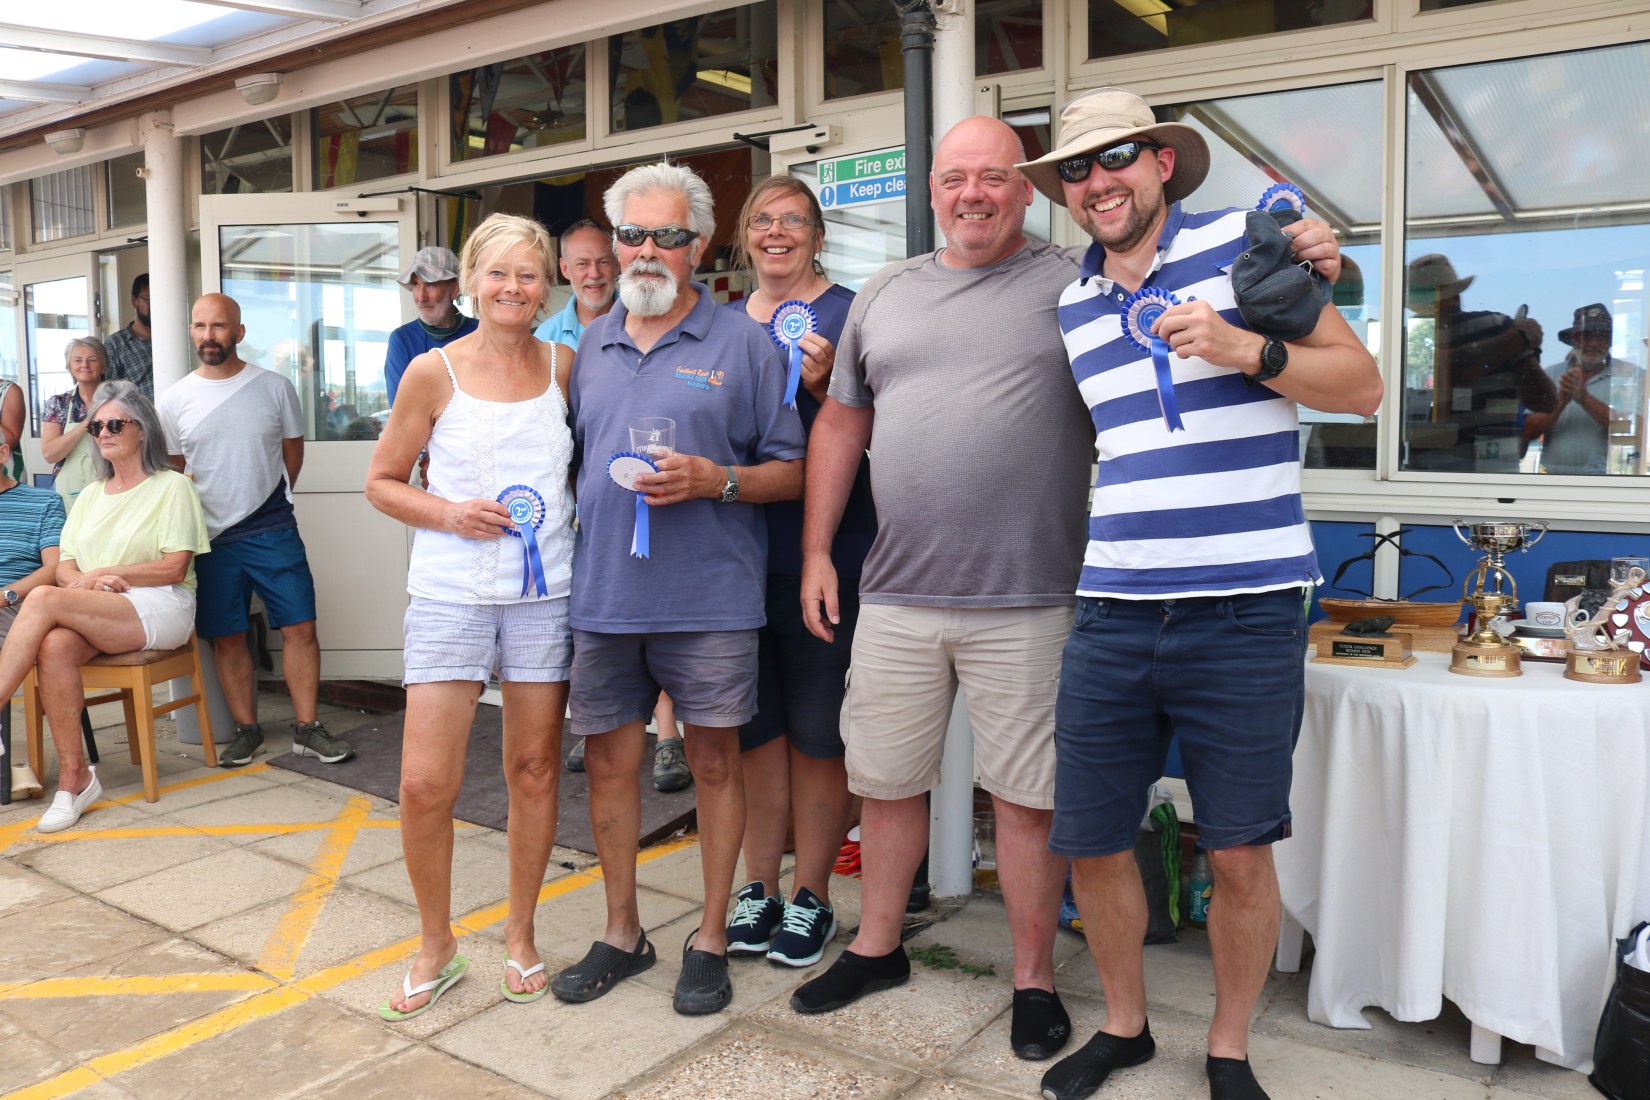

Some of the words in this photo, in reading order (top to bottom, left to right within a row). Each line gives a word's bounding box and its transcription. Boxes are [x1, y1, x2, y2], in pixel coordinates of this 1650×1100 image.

[855, 159, 882, 176] Fire
[885, 152, 906, 171] exi
[850, 182, 882, 198] Keep
[885, 177, 906, 193] cle
